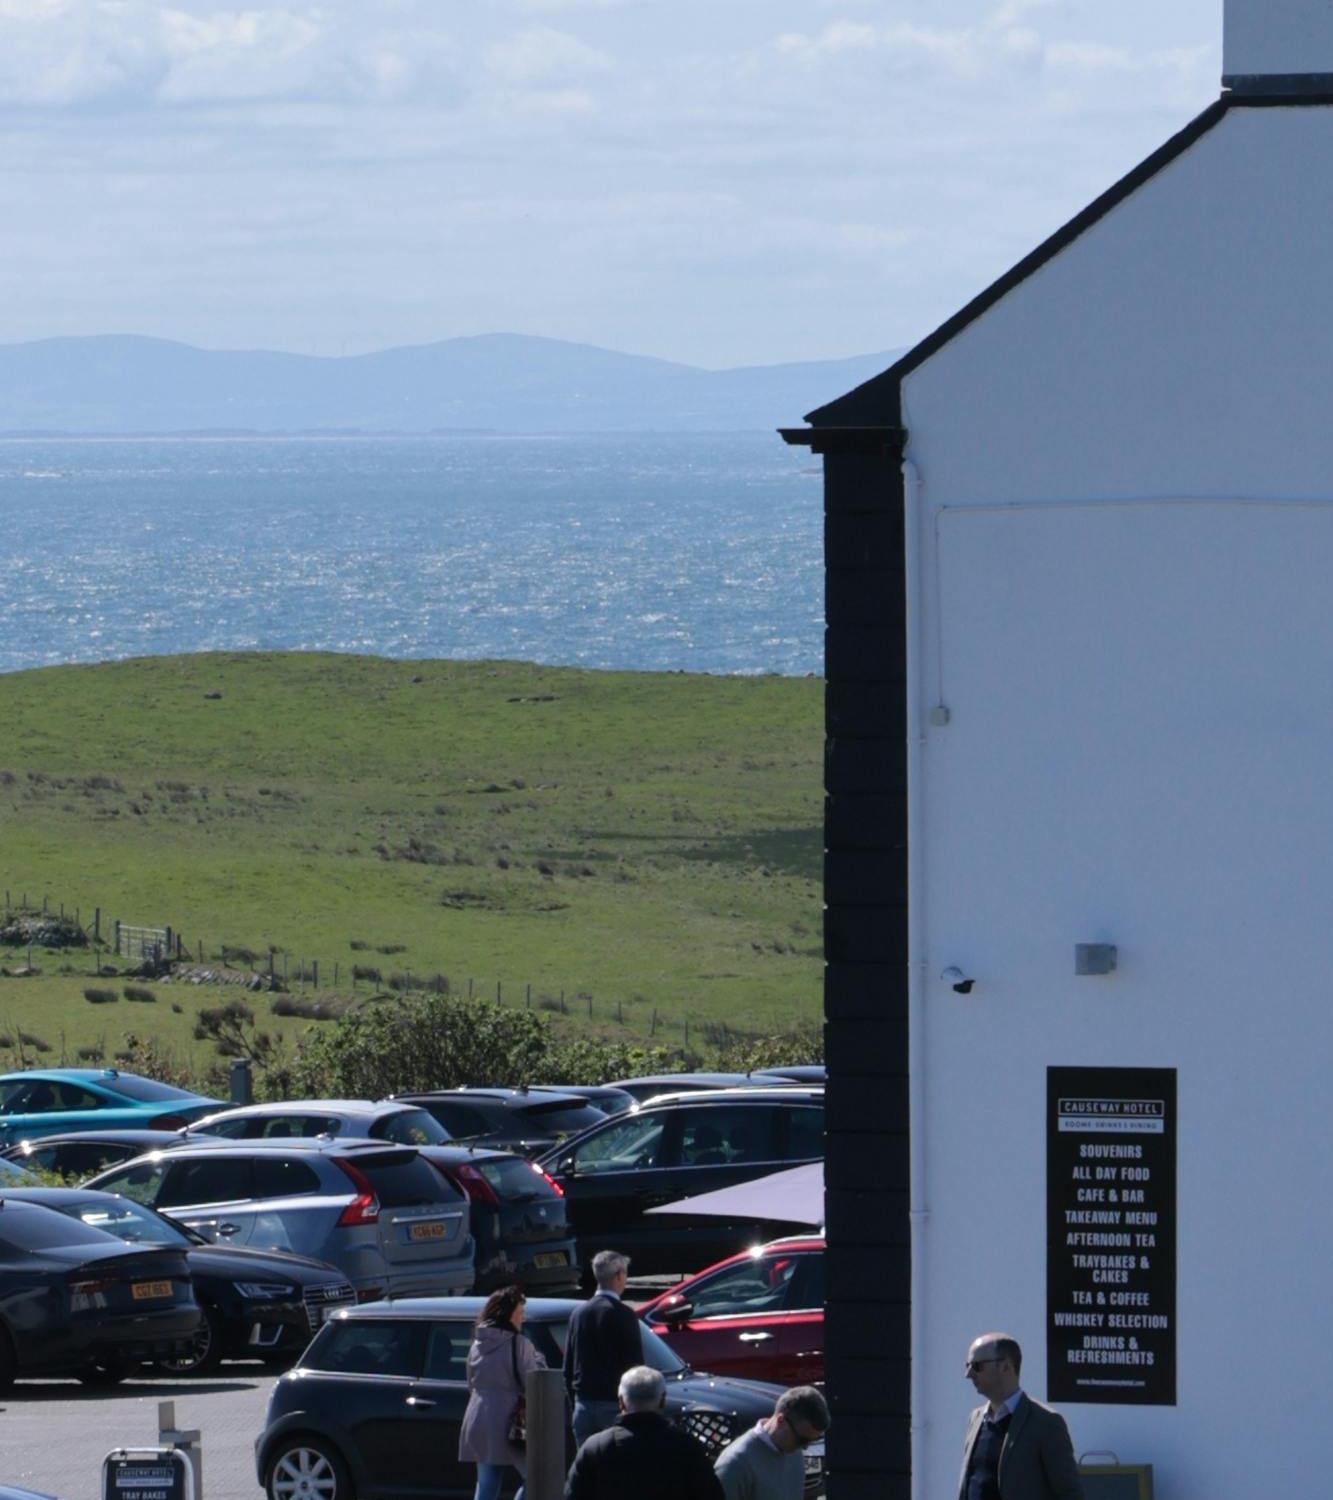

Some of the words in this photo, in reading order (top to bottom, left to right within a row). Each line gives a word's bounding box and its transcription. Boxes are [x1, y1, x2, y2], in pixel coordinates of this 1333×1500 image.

[1064, 1102, 1120, 1113] CAUSEWAY
[1123, 1103, 1158, 1114] HOTEL
[1079, 1144, 1142, 1159] SOUVENIRS
[1072, 1166, 1092, 1180] ALL
[1096, 1166, 1117, 1180] DAY
[1121, 1167, 1150, 1181] FOOD
[1077, 1188, 1105, 1202] CAFE
[1109, 1188, 1118, 1202] &
[1122, 1189, 1145, 1203] BAR
[1065, 1210, 1121, 1224] TAKEAWAY
[1125, 1211, 1158, 1225] MENU
[1066, 1232, 1131, 1246] AFTERNOON
[1135, 1233, 1156, 1247] TEA
[1072, 1254, 1136, 1269] TRAYBAKES
[1140, 1255, 1150, 1269] &
[1092, 1269, 1129, 1283] CAKES
[1072, 1290, 1093, 1305] TEA
[1096, 1291, 1106, 1305] &
[1109, 1292, 1150, 1306] COFFEE
[1054, 1312, 1104, 1327] WHISKEY
[1108, 1313, 1168, 1329] SELECTION
[1083, 1335, 1125, 1350] DRINKS
[1128, 1336, 1138, 1350] &
[1067, 1349, 1154, 1365] REFRESHMENTS
[121, 1491, 140, 1500] TRAY
[142, 1491, 167, 1500] BAKES
